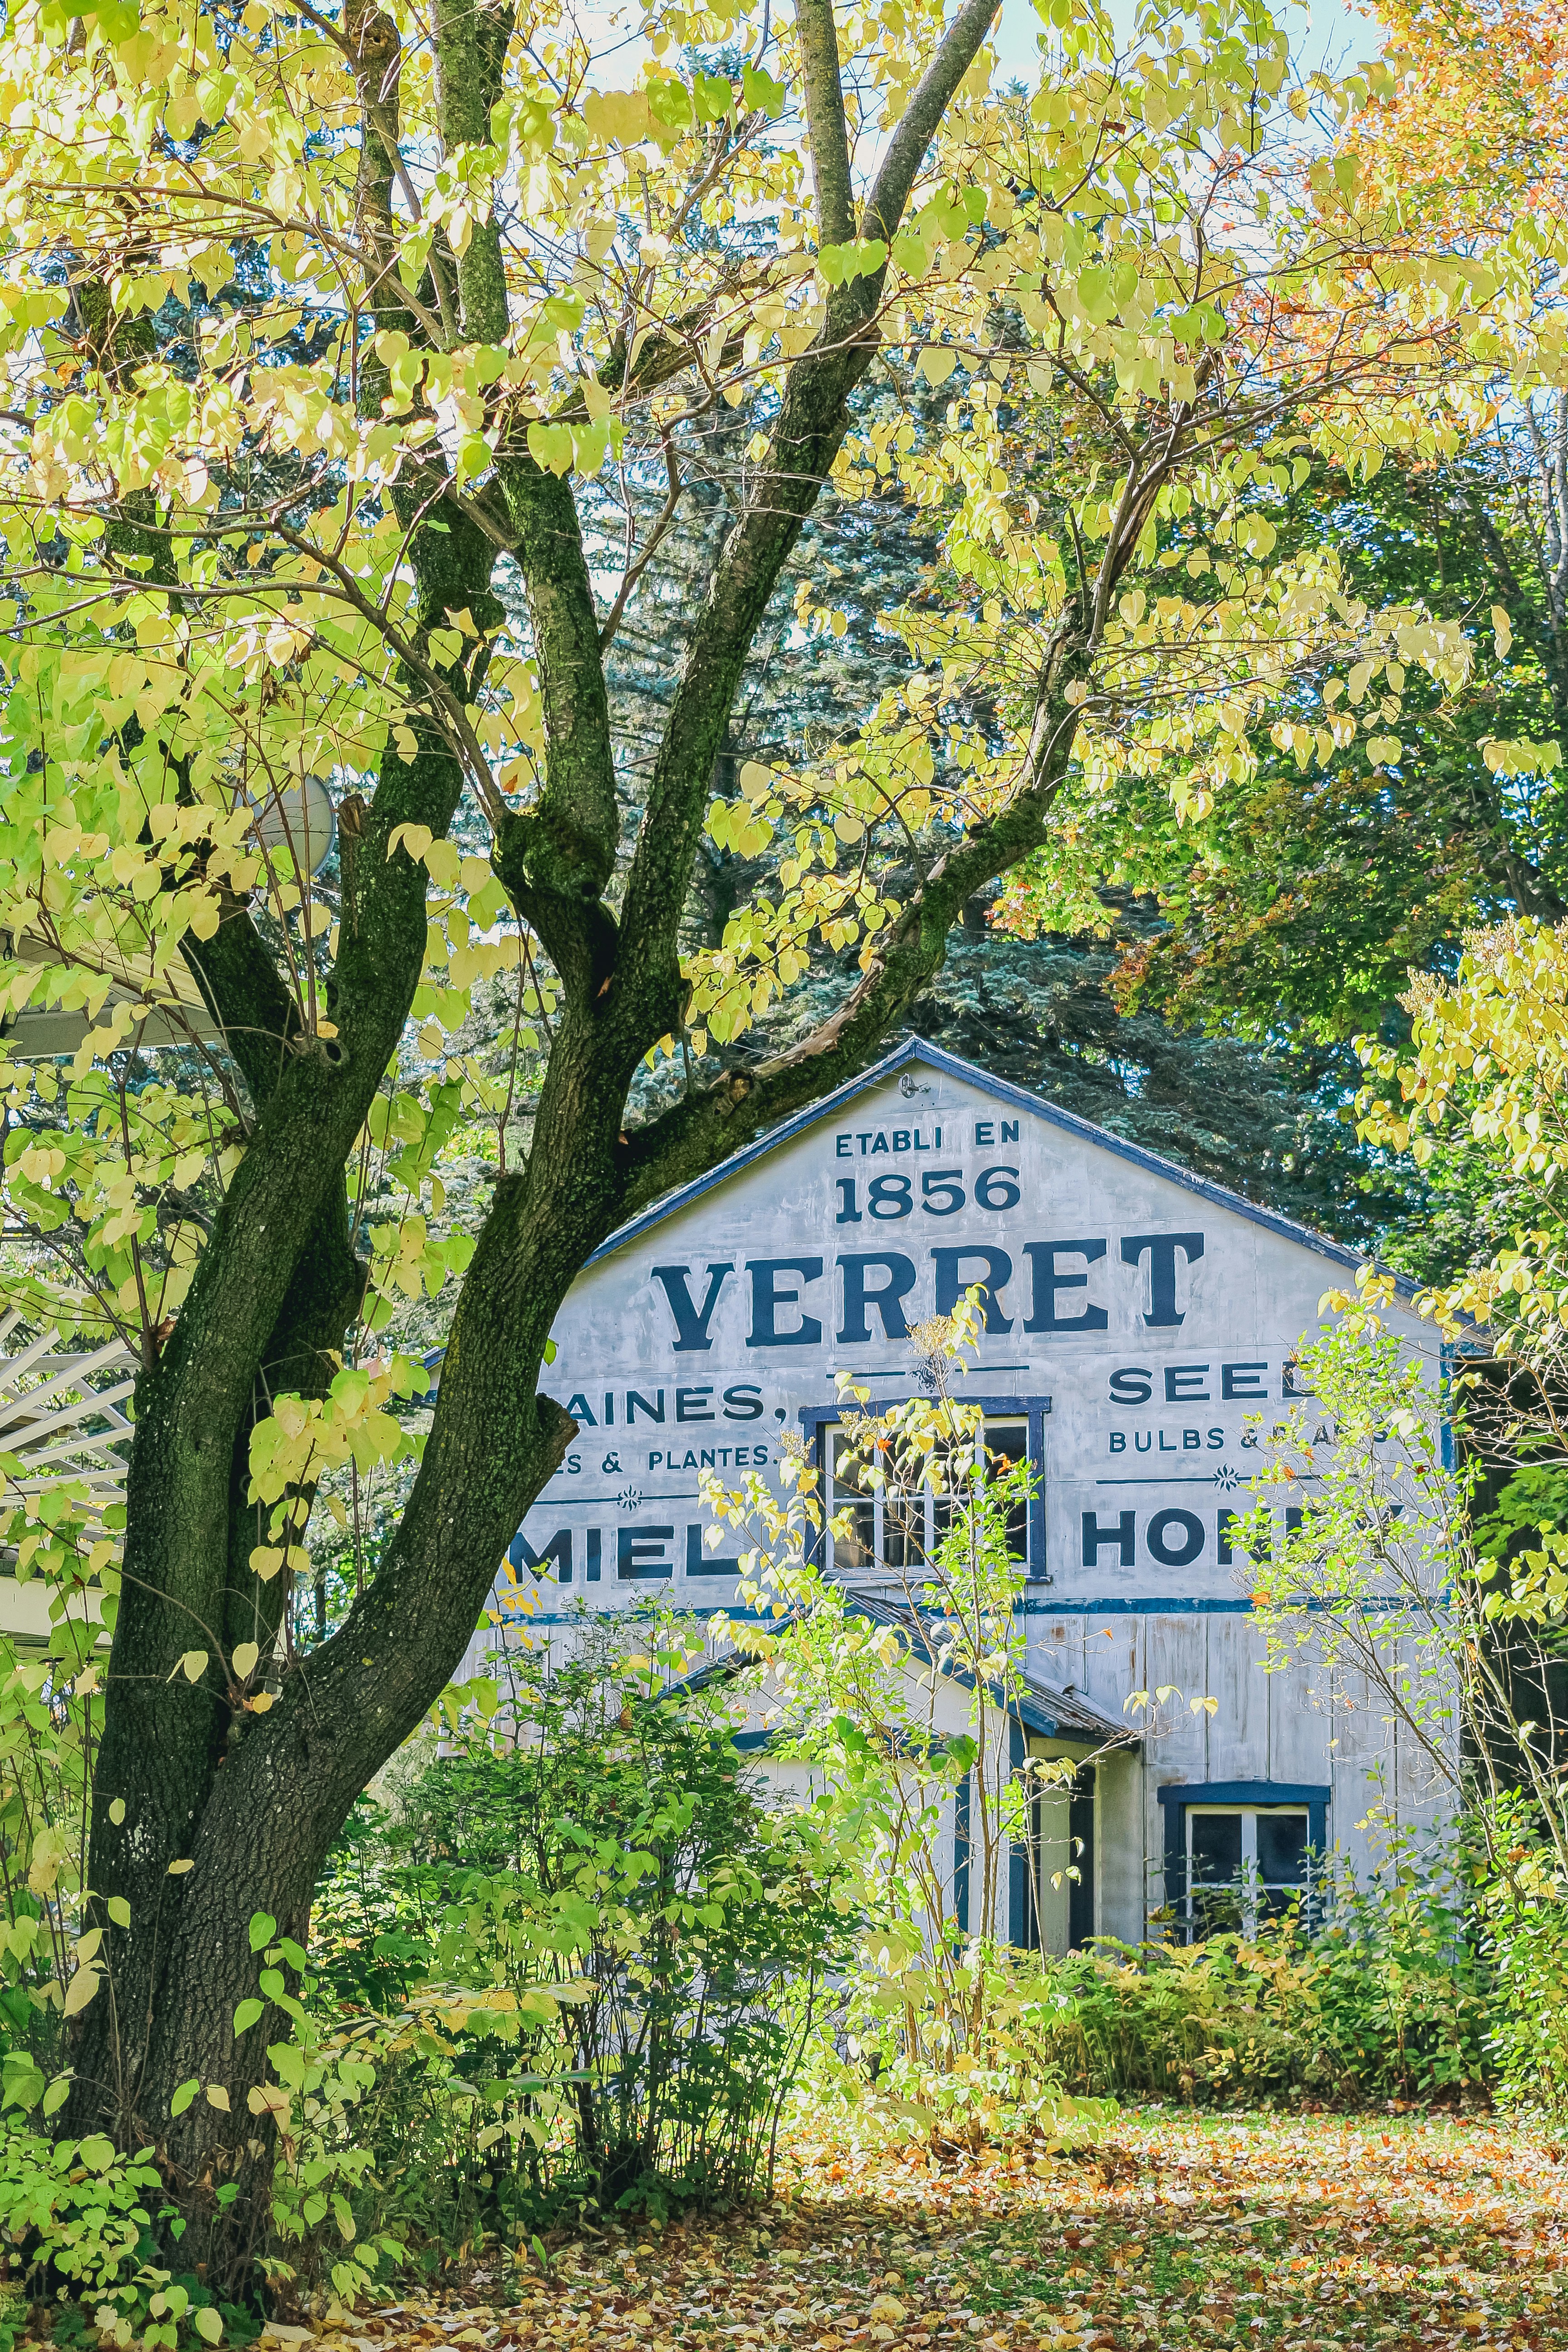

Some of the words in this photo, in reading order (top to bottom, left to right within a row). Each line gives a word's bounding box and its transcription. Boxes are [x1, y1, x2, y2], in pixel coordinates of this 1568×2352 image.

[836, 1126, 942, 1158] ETABLI
[975, 1119, 1019, 1146] EN
[836, 1166, 1021, 1224] 1856
[651, 1232, 1205, 1352] VERRET
[1108, 1362, 1388, 1405] SEE
[601, 1451, 624, 1474] &
[649, 1445, 779, 1471] PLANTES.
[1109, 1427, 1224, 1453] BULBS
[1240, 1428, 1258, 1448] &
[508, 1524, 742, 1584] MIEL
